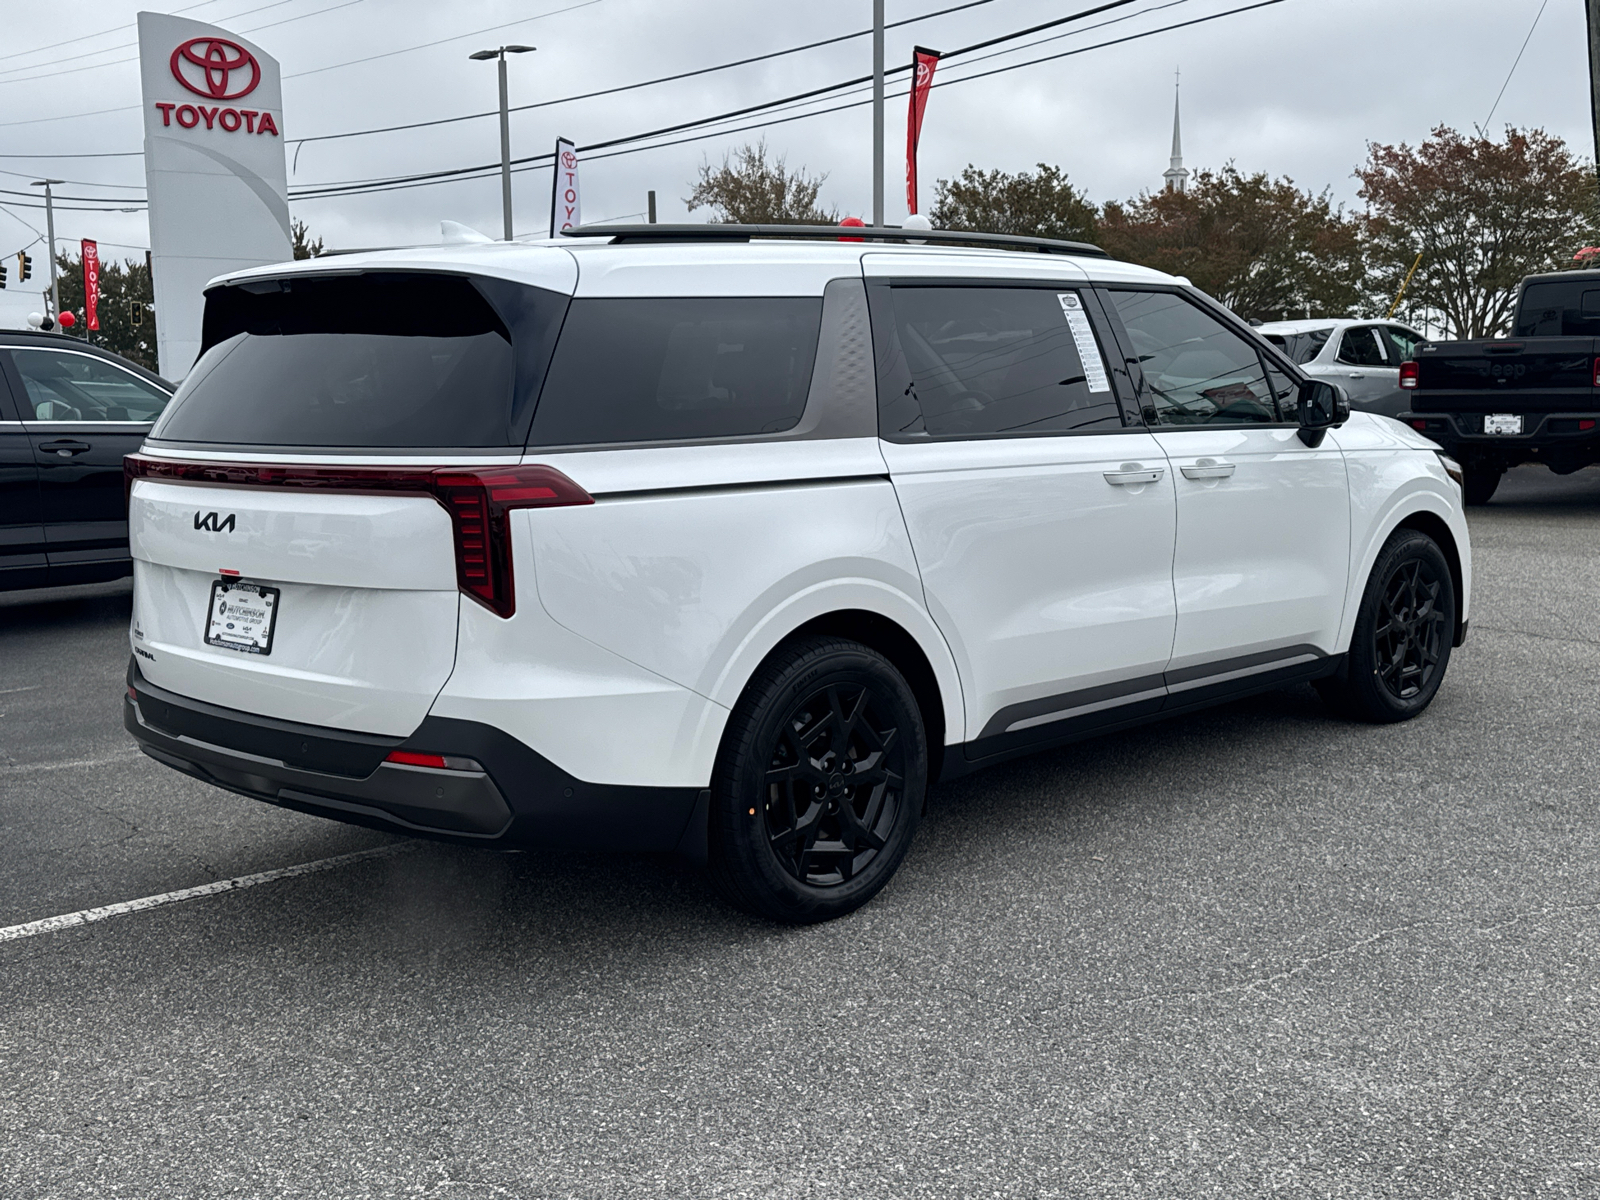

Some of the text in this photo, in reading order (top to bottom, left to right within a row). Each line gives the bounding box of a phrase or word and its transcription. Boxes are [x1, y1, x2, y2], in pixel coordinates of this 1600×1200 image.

[155, 102, 279, 136] TOYOTA
[1479, 362, 1526, 380] Jeep
[193, 510, 236, 533] KIA
